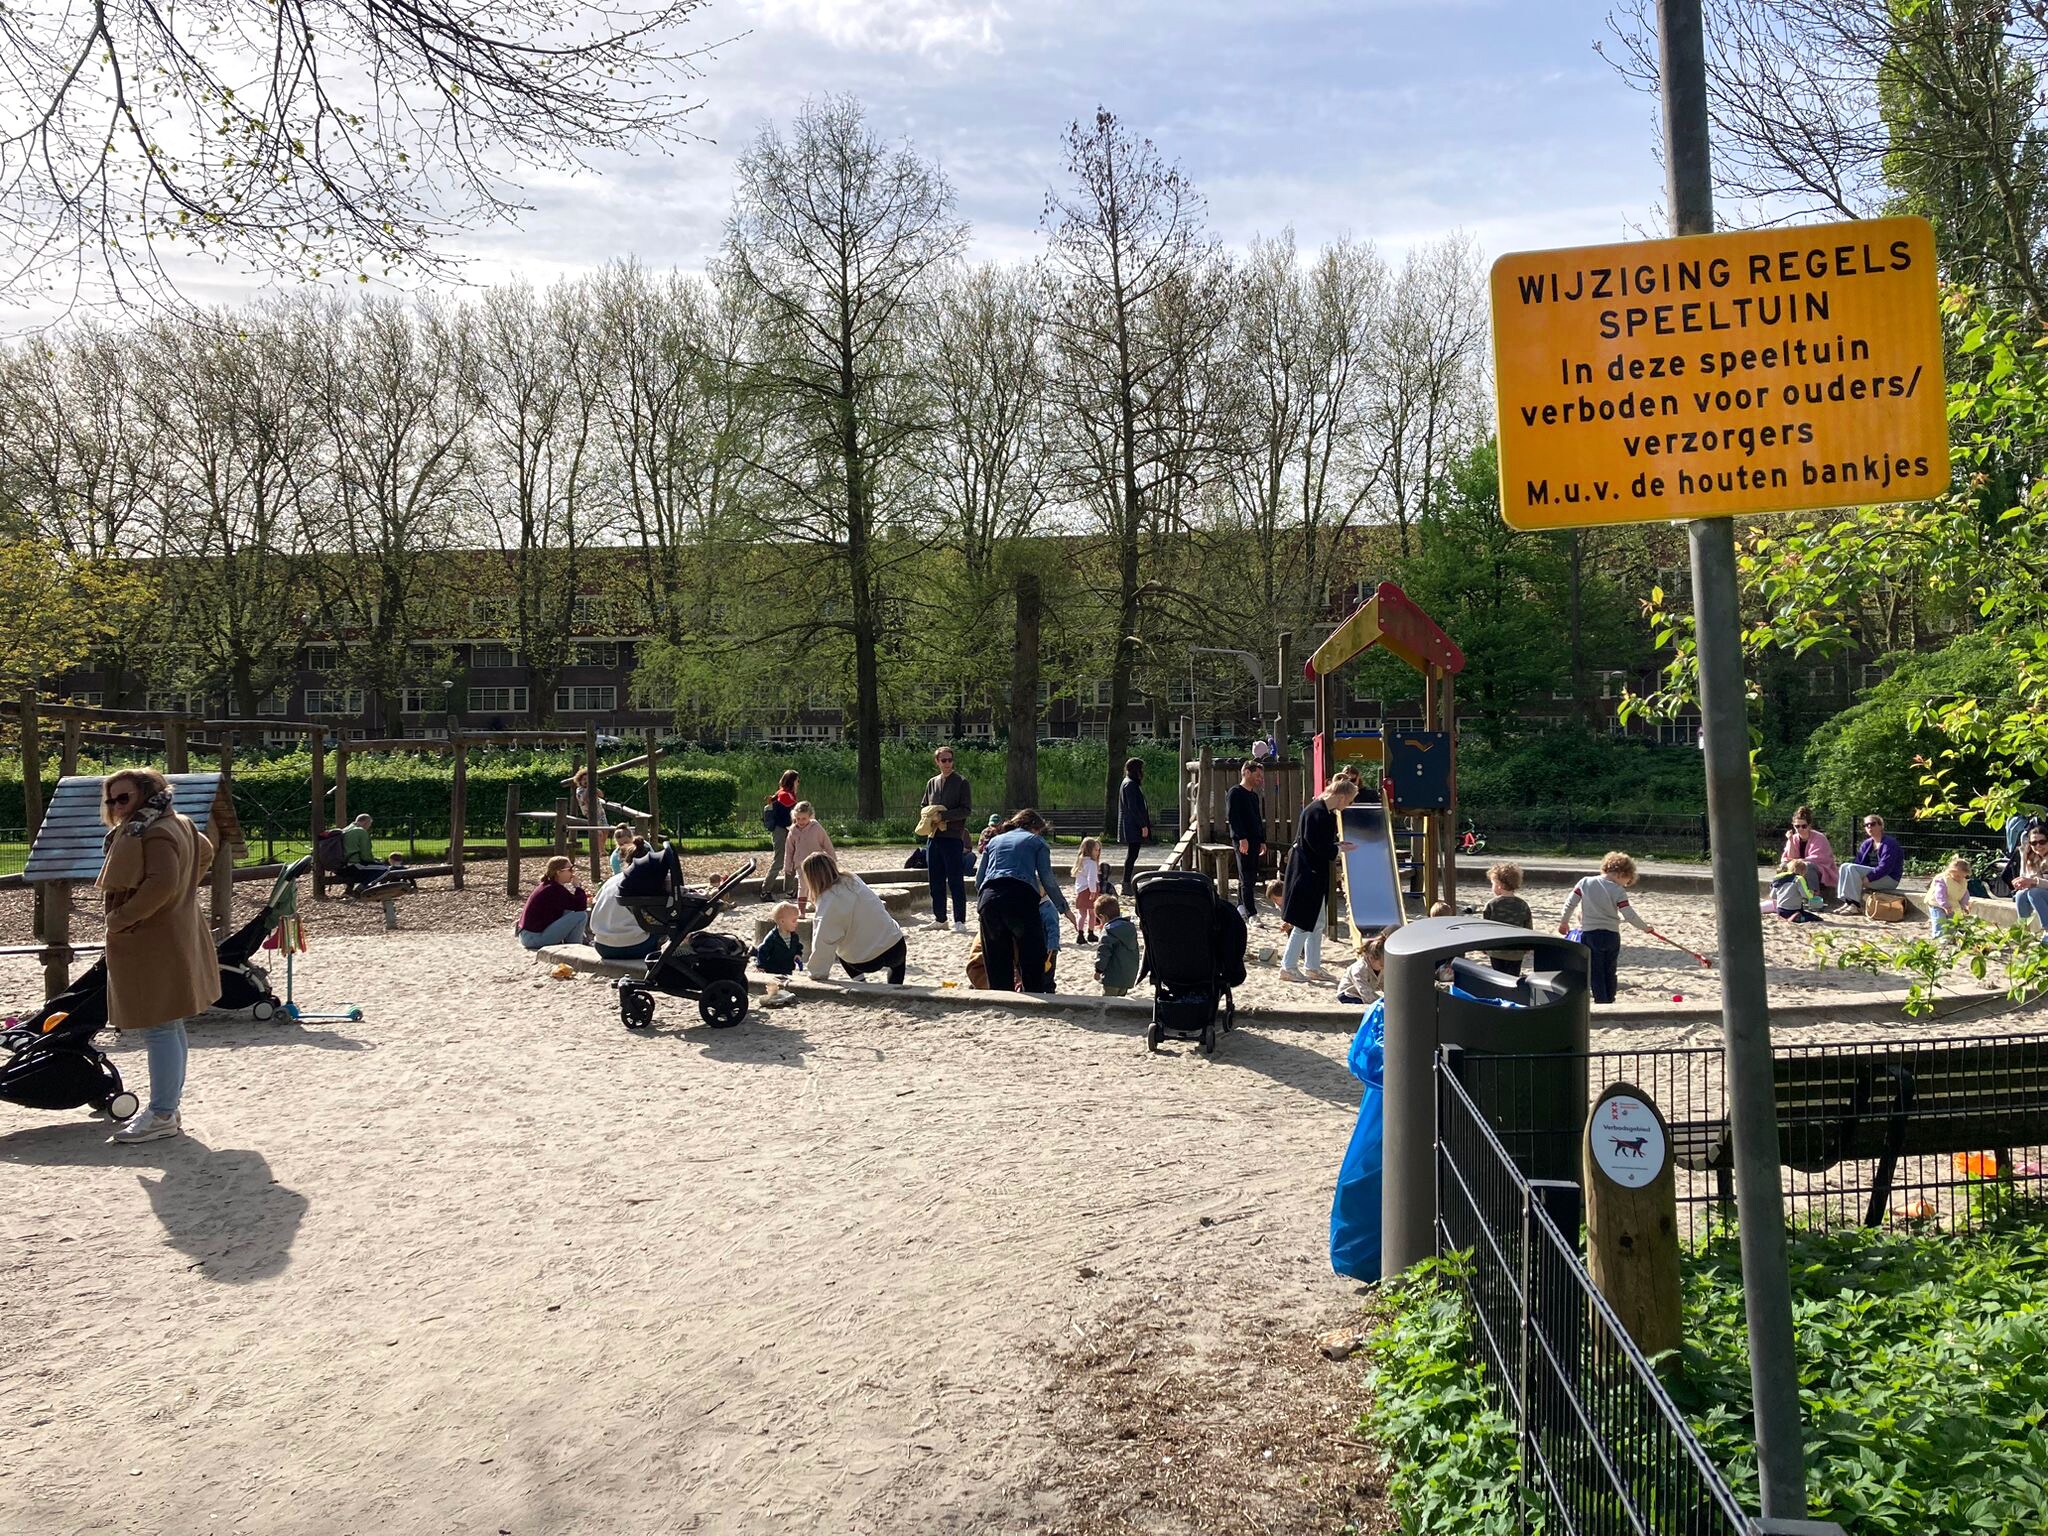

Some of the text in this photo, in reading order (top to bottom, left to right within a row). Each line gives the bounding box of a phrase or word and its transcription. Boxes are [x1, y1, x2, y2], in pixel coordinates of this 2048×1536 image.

[1517, 240, 1912, 305] WIJZIGING REGELS
[1599, 290, 1830, 340] SPEELTUIN
[1561, 334, 1869, 385] In deze speeltuin
[1520, 365, 1923, 427] verboden voor ouders/
[1623, 422, 1814, 458] verzorgers
[1527, 452, 1929, 506] M.u.v. de houten bankjes
